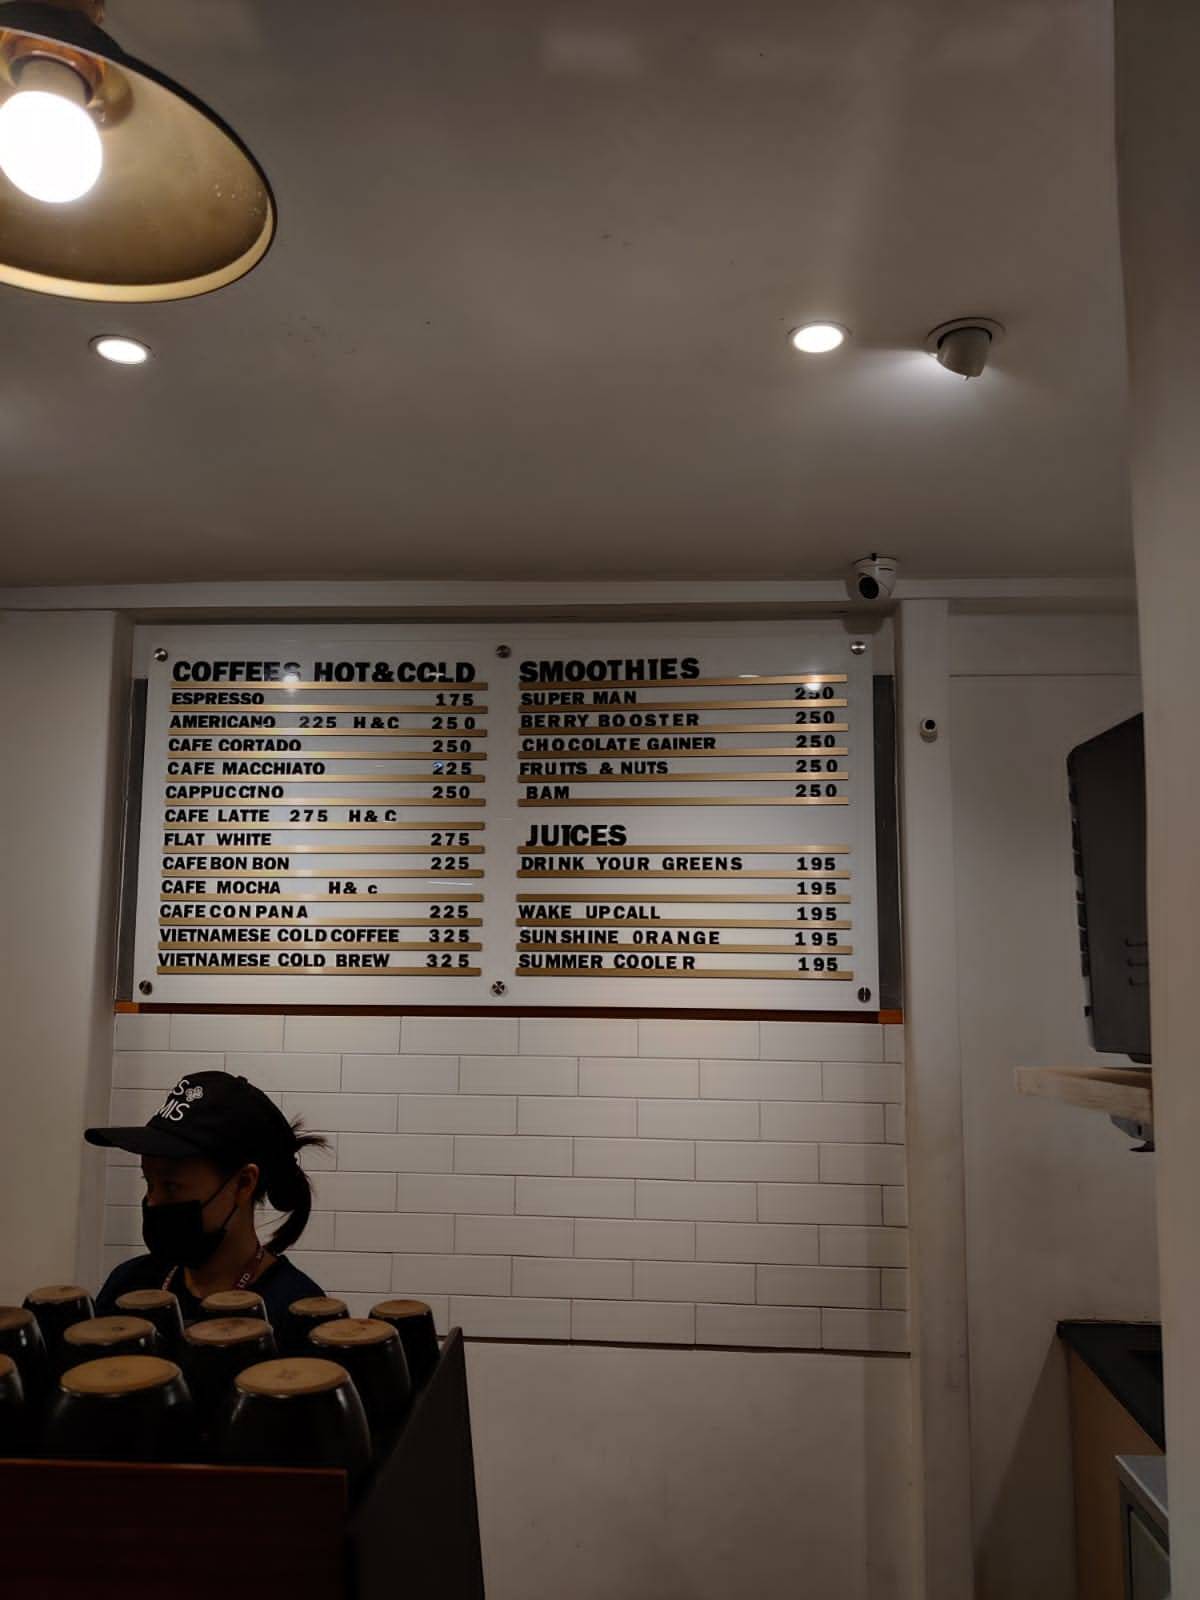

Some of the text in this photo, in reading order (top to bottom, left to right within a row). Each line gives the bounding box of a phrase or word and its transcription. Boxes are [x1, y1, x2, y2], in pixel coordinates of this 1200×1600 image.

[519, 657, 700, 682] SMOOTHIES
[172, 692, 265, 705] ESPRESSO
[435, 693, 474, 707] 175
[521, 690, 637, 705] SUPER MAN
[169, 716, 276, 729] AMERICANO
[299, 716, 337, 729] 225
[432, 717, 476, 730] 250
[520, 713, 699, 728] BERRY BOOSTER
[795, 711, 835, 724] 250
[168, 739, 302, 752] CAFE CORTADO
[432, 740, 472, 753] 250
[522, 736, 716, 752] CHOCOLATE GAINER
[795, 735, 835, 749] 250
[167, 762, 325, 775] CAFE MACCHIATO
[432, 761, 472, 775] 225
[519, 761, 669, 775] FRUITS & NUTS
[795, 760, 838, 773] 250
[165, 786, 284, 799] CAPPUCCINO
[432, 786, 470, 799] 250
[526, 786, 570, 800] BAM
[795, 784, 838, 798] 250
[164, 809, 209, 822] CAFE
[217, 810, 270, 822] LATTE
[289, 810, 328, 822] 275
[164, 833, 272, 846] FLAT WHITE
[430, 833, 470, 846] 275
[525, 824, 627, 847] JUICES
[162, 857, 289, 870] CAFE BON BON
[430, 857, 470, 870] 225
[521, 857, 743, 871] DRINK YOUR GREENS
[796, 857, 836, 871] 195
[161, 880, 281, 894] CAFE MOCHA
[796, 881, 837, 896] 195
[160, 904, 308, 918] CAFE CON PANA
[429, 905, 469, 919] 225
[518, 905, 572, 920] WAKE
[796, 907, 837, 921] 195
[159, 928, 400, 943] VIETNAMESE COLD COFFEE
[428, 929, 470, 943] 325
[795, 932, 838, 946] 195
[158, 953, 390, 968] VIETNAMESE COLD BREW
[426, 954, 470, 968] 325
[518, 954, 695, 970] SUMMER COOLER
[798, 957, 838, 971] 195
